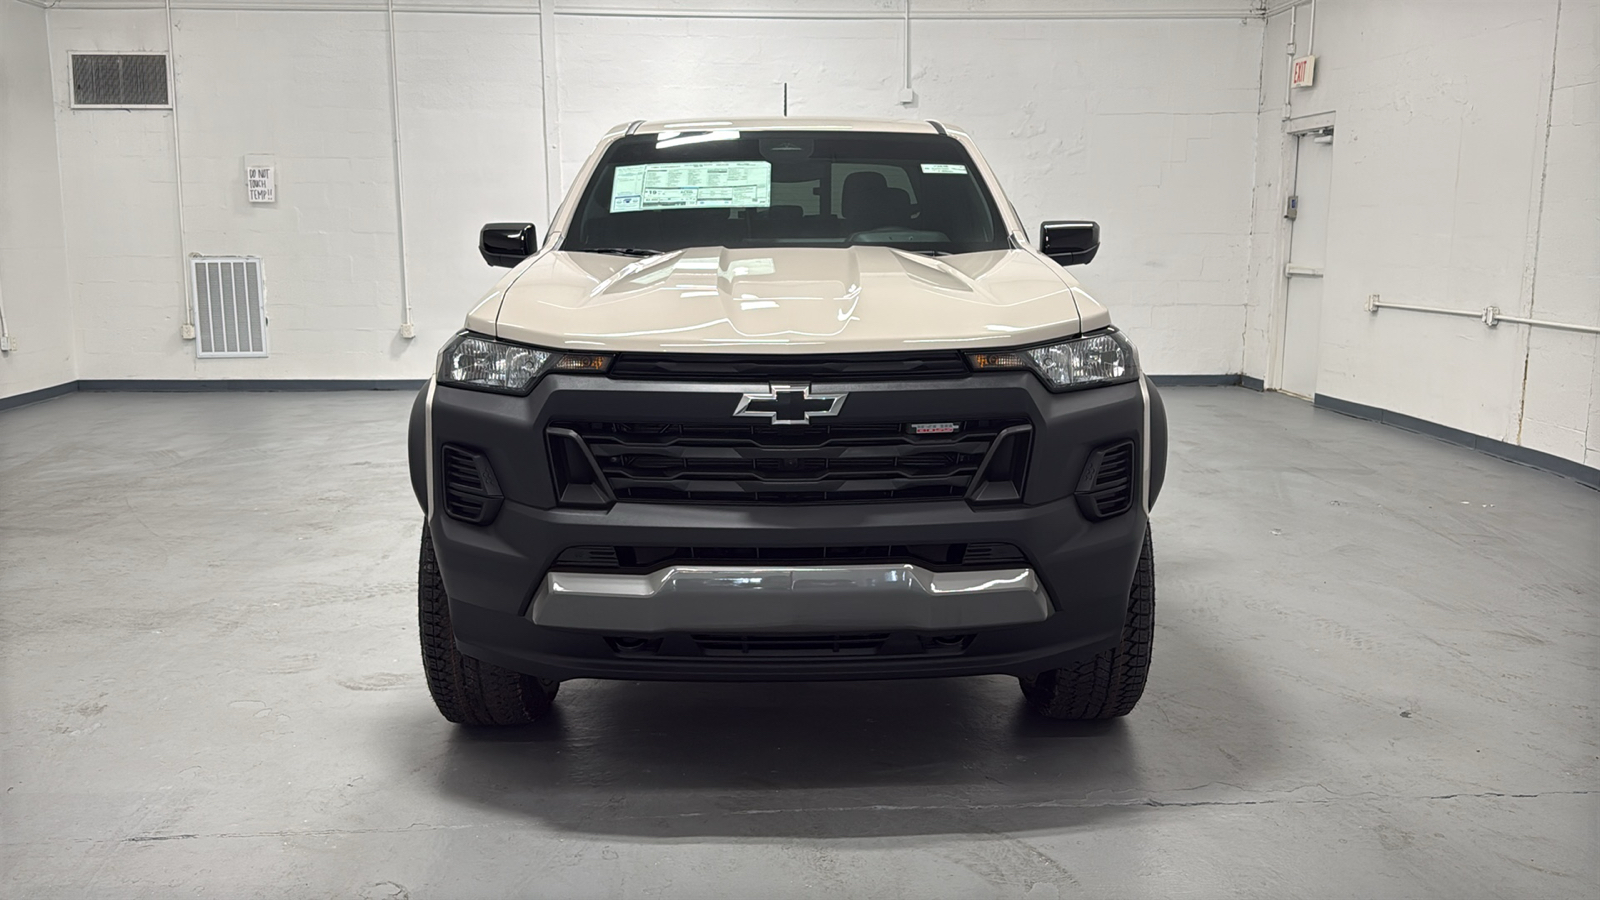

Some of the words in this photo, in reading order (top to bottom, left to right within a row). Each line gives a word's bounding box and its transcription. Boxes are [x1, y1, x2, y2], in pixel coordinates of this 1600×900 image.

[1294, 61, 1307, 83] EXIT
[249, 169, 256, 178] DO
[258, 169, 270, 179] NOT
[249, 180, 266, 188] TOUCH
